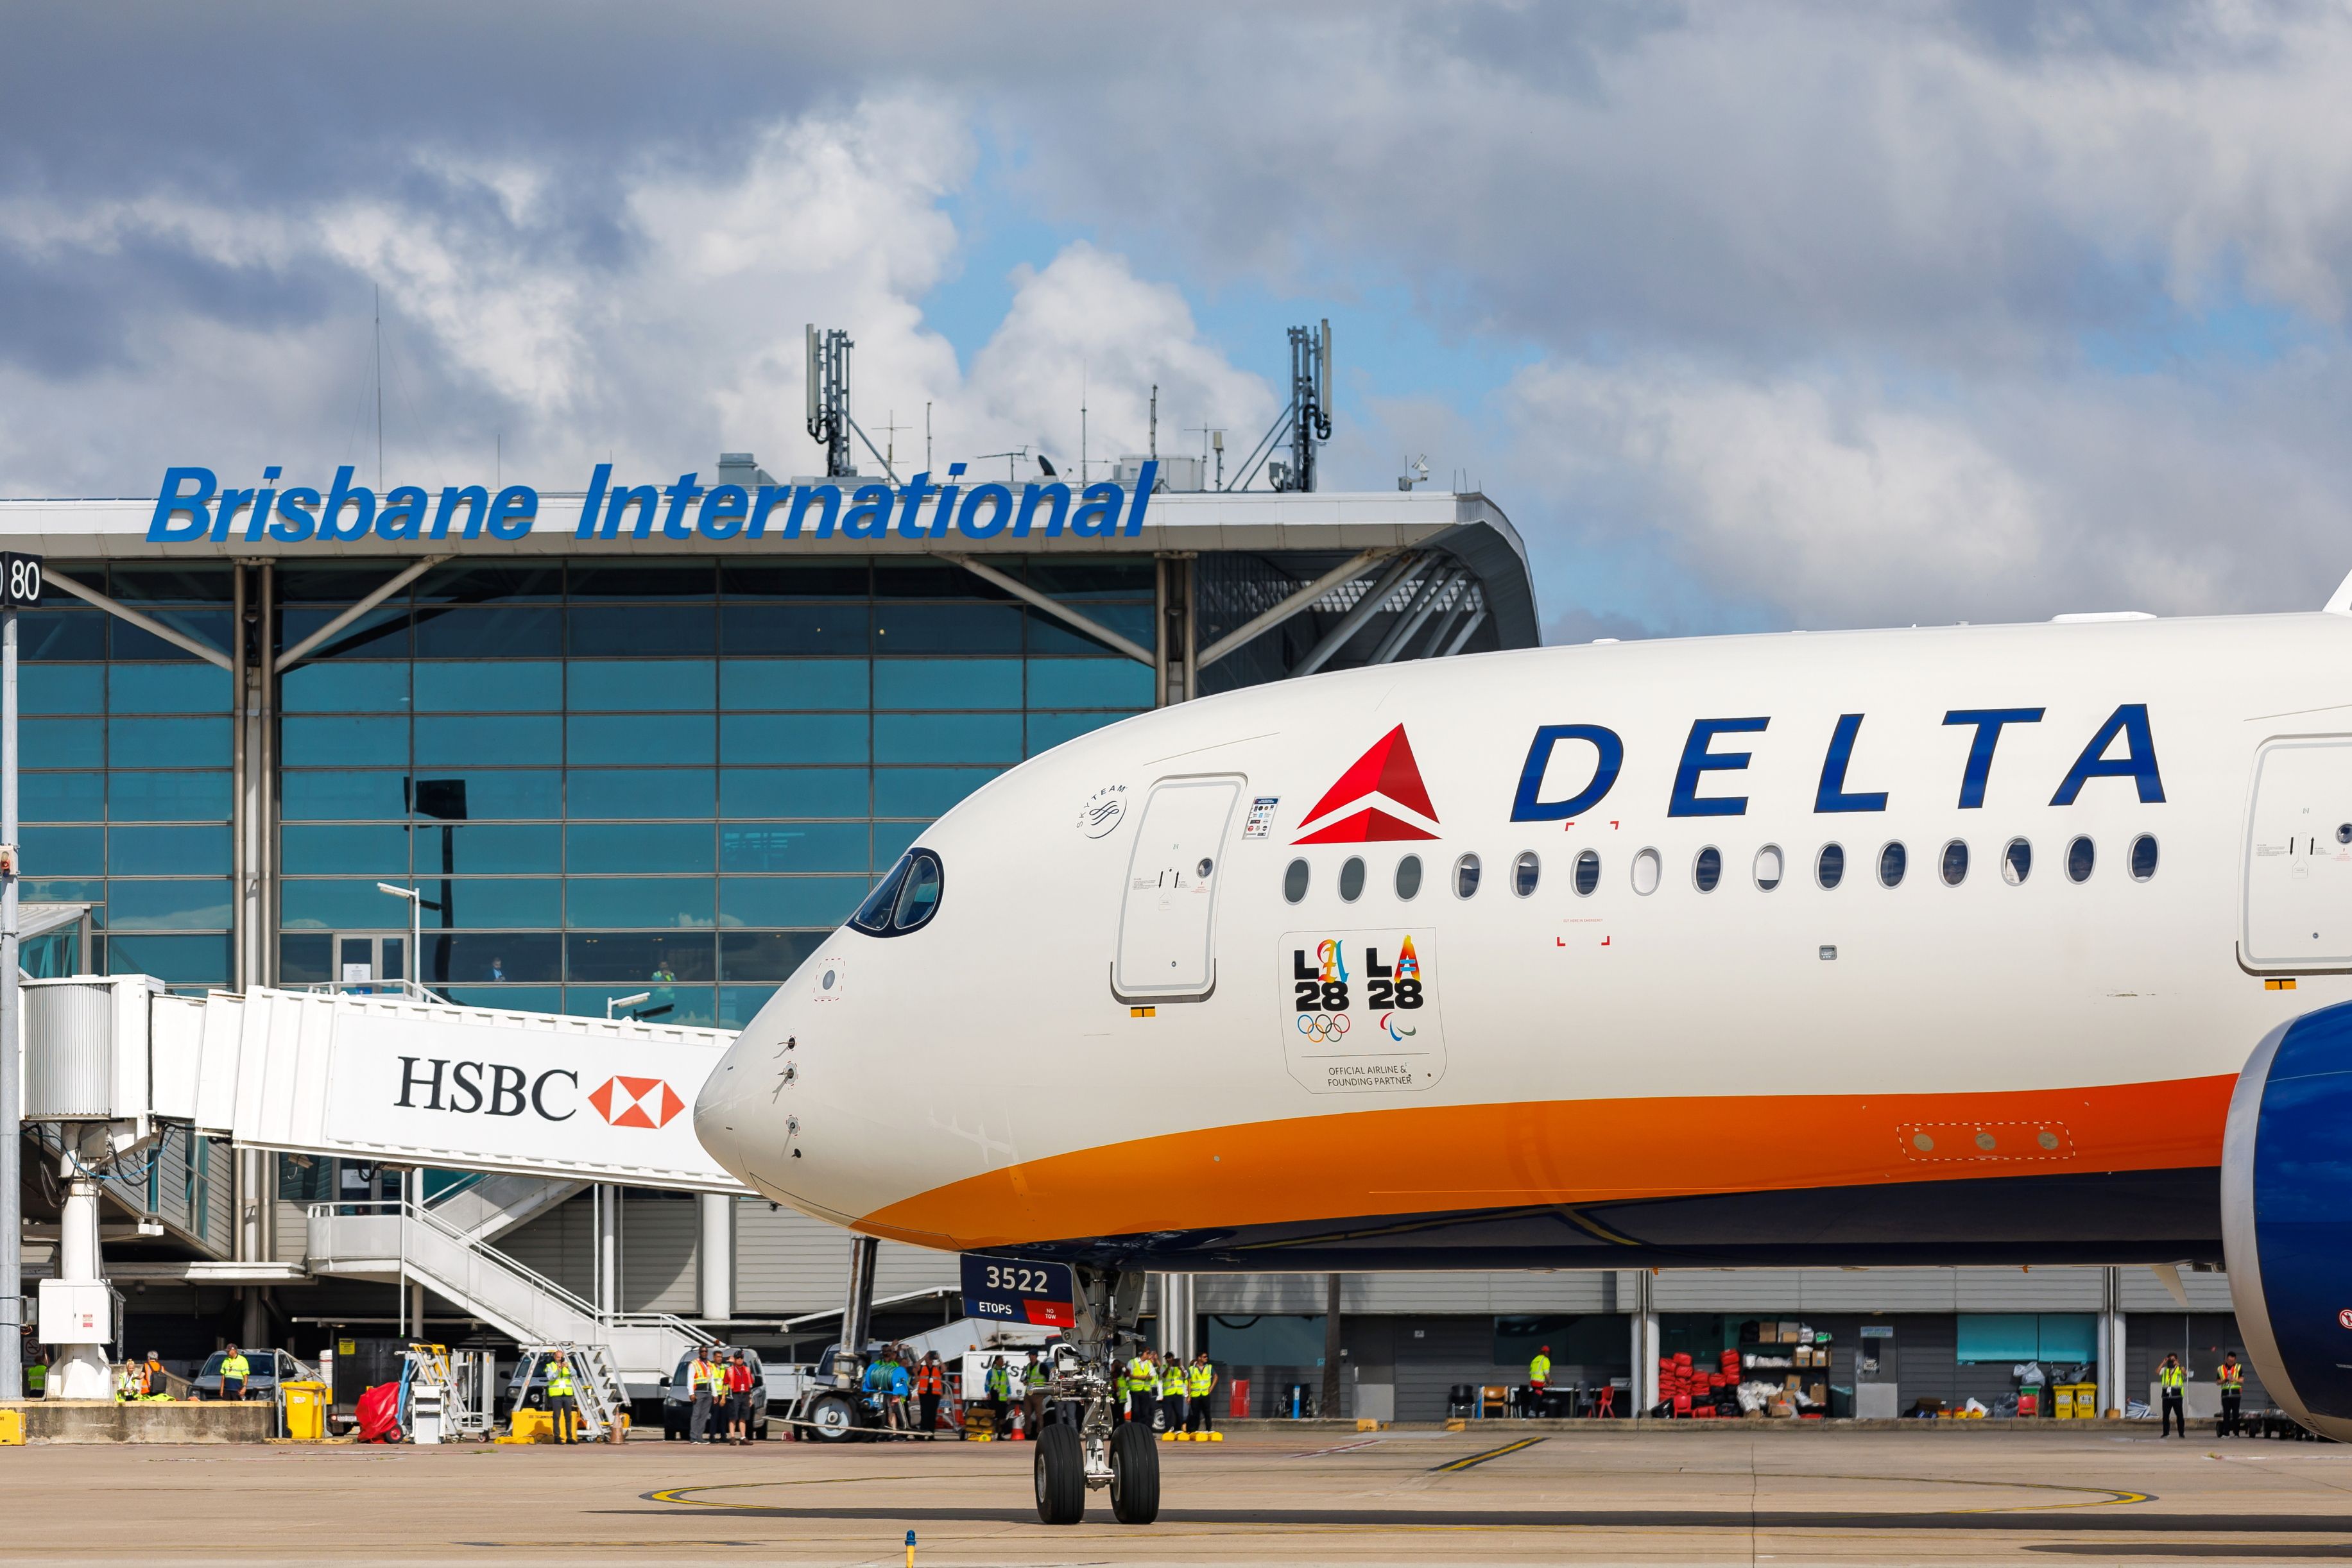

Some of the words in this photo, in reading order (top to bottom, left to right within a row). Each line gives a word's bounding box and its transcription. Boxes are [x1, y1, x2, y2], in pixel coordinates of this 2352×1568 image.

[146, 466, 538, 543] Brisbane
[575, 461, 1159, 540] International
[11, 559, 40, 601] 80
[1509, 703, 2167, 823] DELTA
[1076, 785, 1126, 828] SKYTEAM
[1294, 939, 1350, 983] LA
[1366, 934, 1421, 984] LA
[1295, 981, 1350, 1012] 28
[1368, 978, 1423, 1010] 28
[393, 1056, 578, 1121] HSBC
[1328, 1067, 1365, 1075] OFFICIAL
[1367, 1066, 1398, 1075] AIRLINE
[1400, 1065, 1407, 1073] &
[1328, 1078, 1373, 1087] FOUNDING
[1375, 1076, 1412, 1086] PARTNER
[986, 1266, 1048, 1293] 3522
[979, 1302, 1012, 1315] ETOPS
